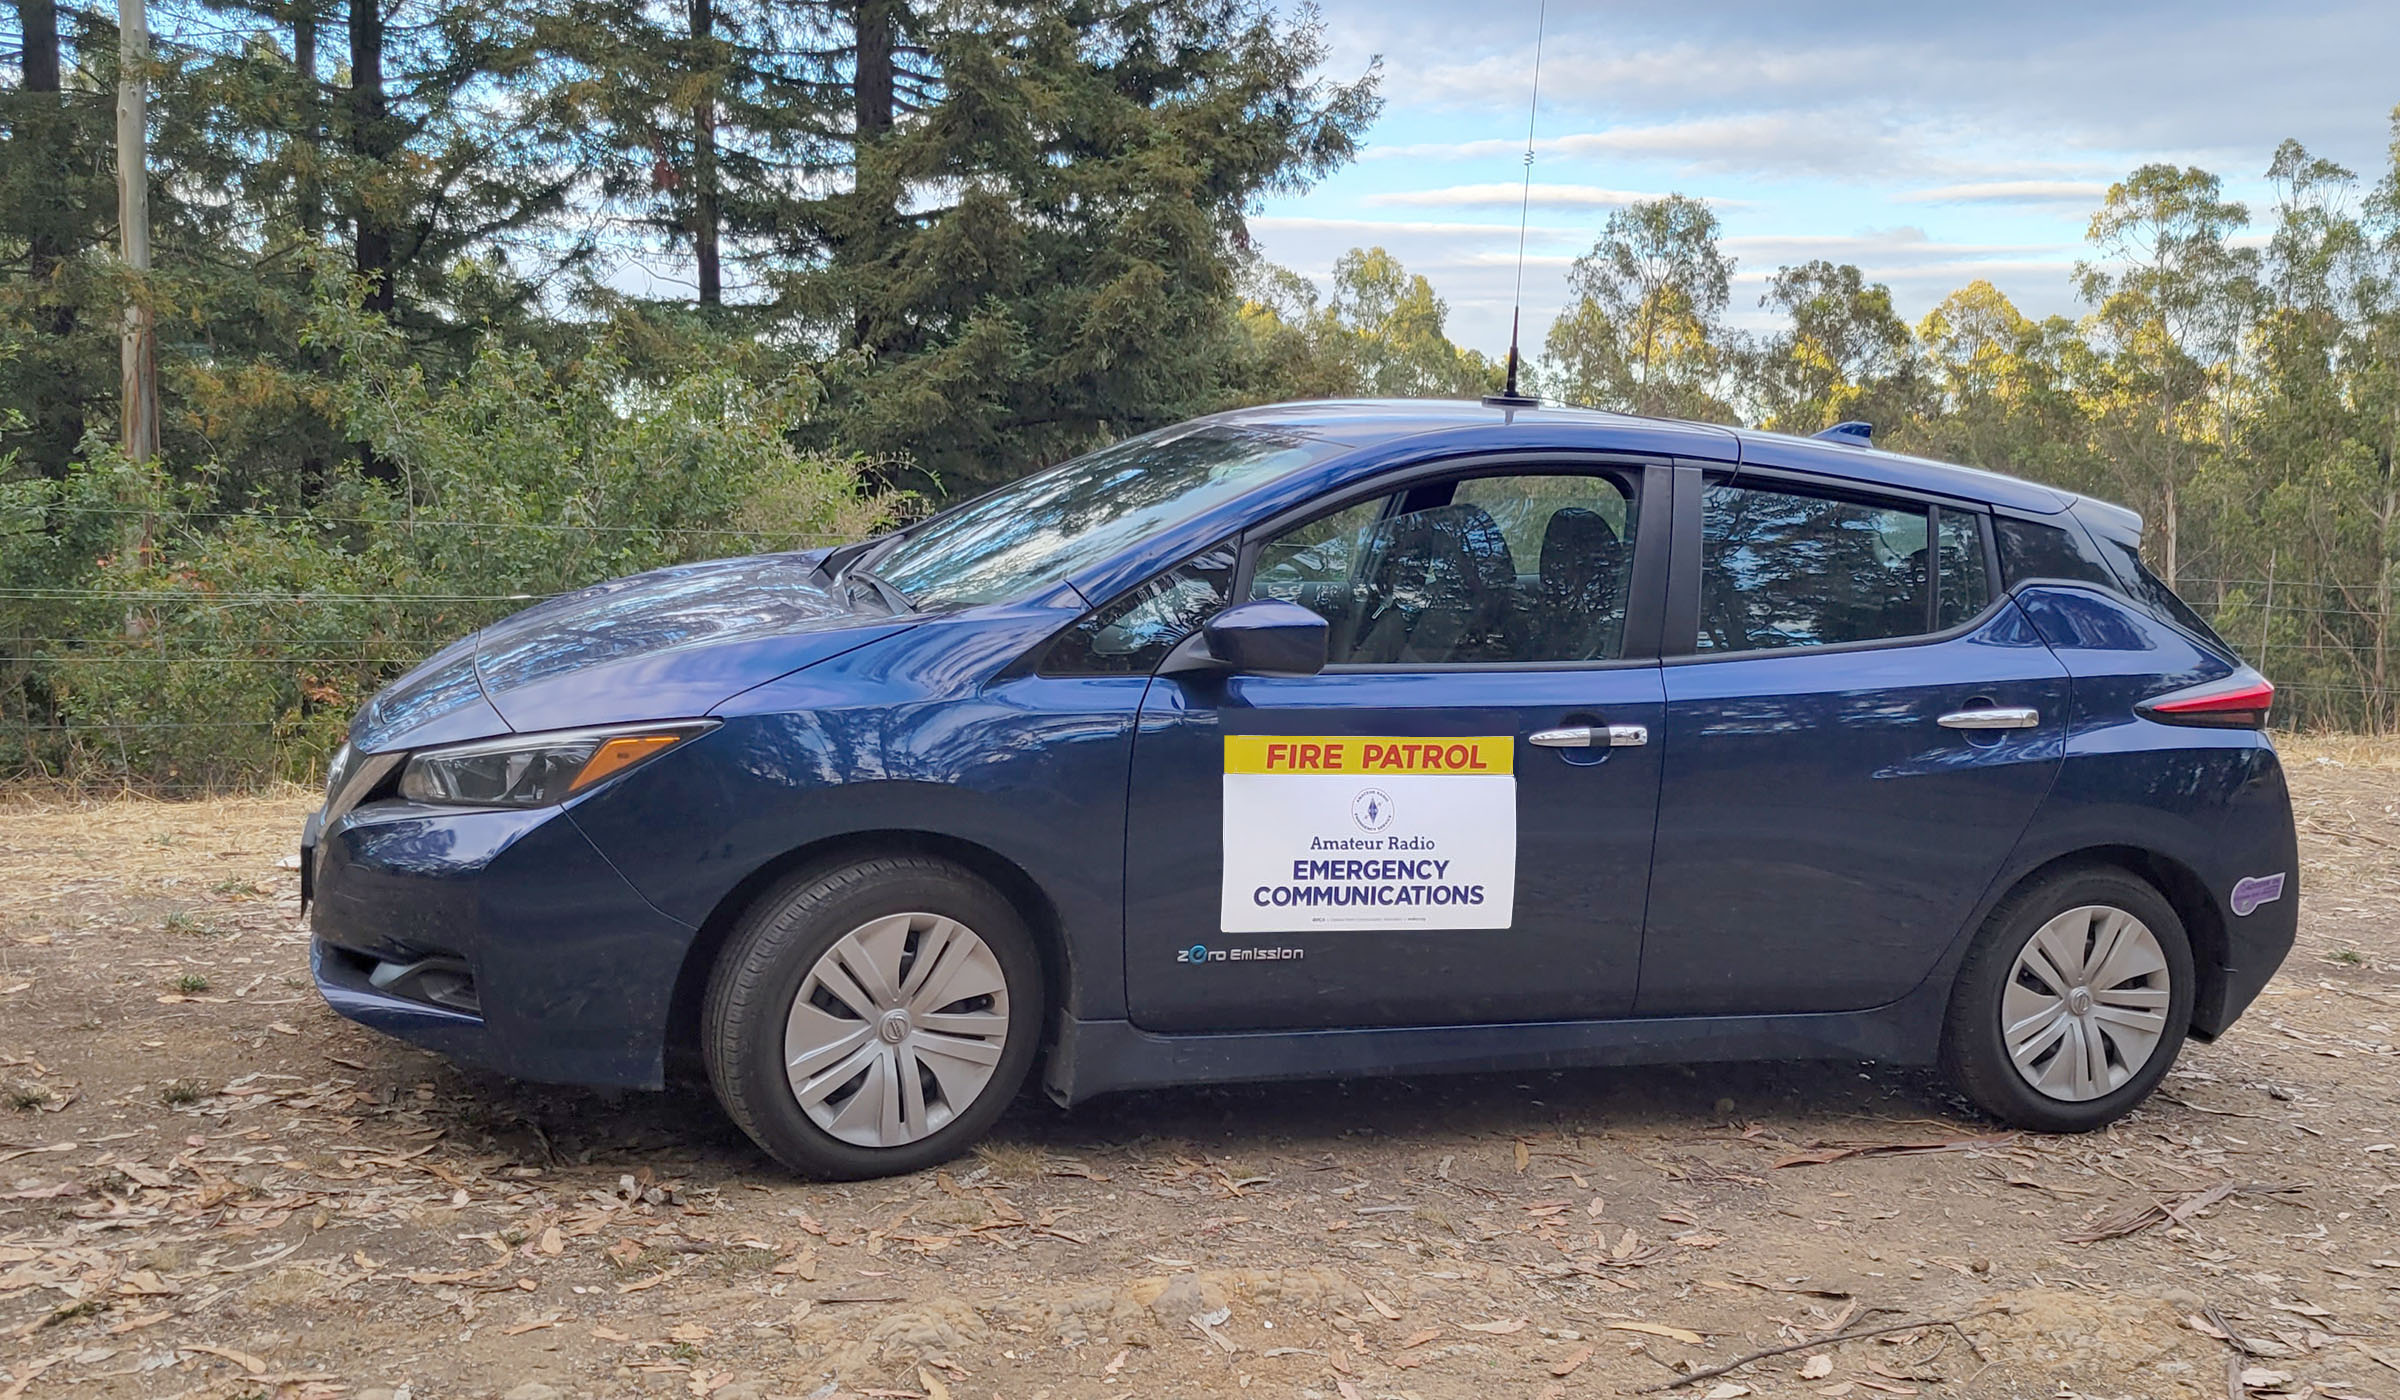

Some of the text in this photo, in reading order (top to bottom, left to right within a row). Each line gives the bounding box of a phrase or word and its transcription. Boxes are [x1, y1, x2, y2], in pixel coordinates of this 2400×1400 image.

[1266, 744, 1487, 769] FIRE PATROL
[1310, 836, 1435, 850] Amateur Radio
[1293, 860, 1450, 880] EMERGENCY
[1253, 885, 1485, 907] COMMUNICATIONS
[1230, 947, 1304, 960] Emission
